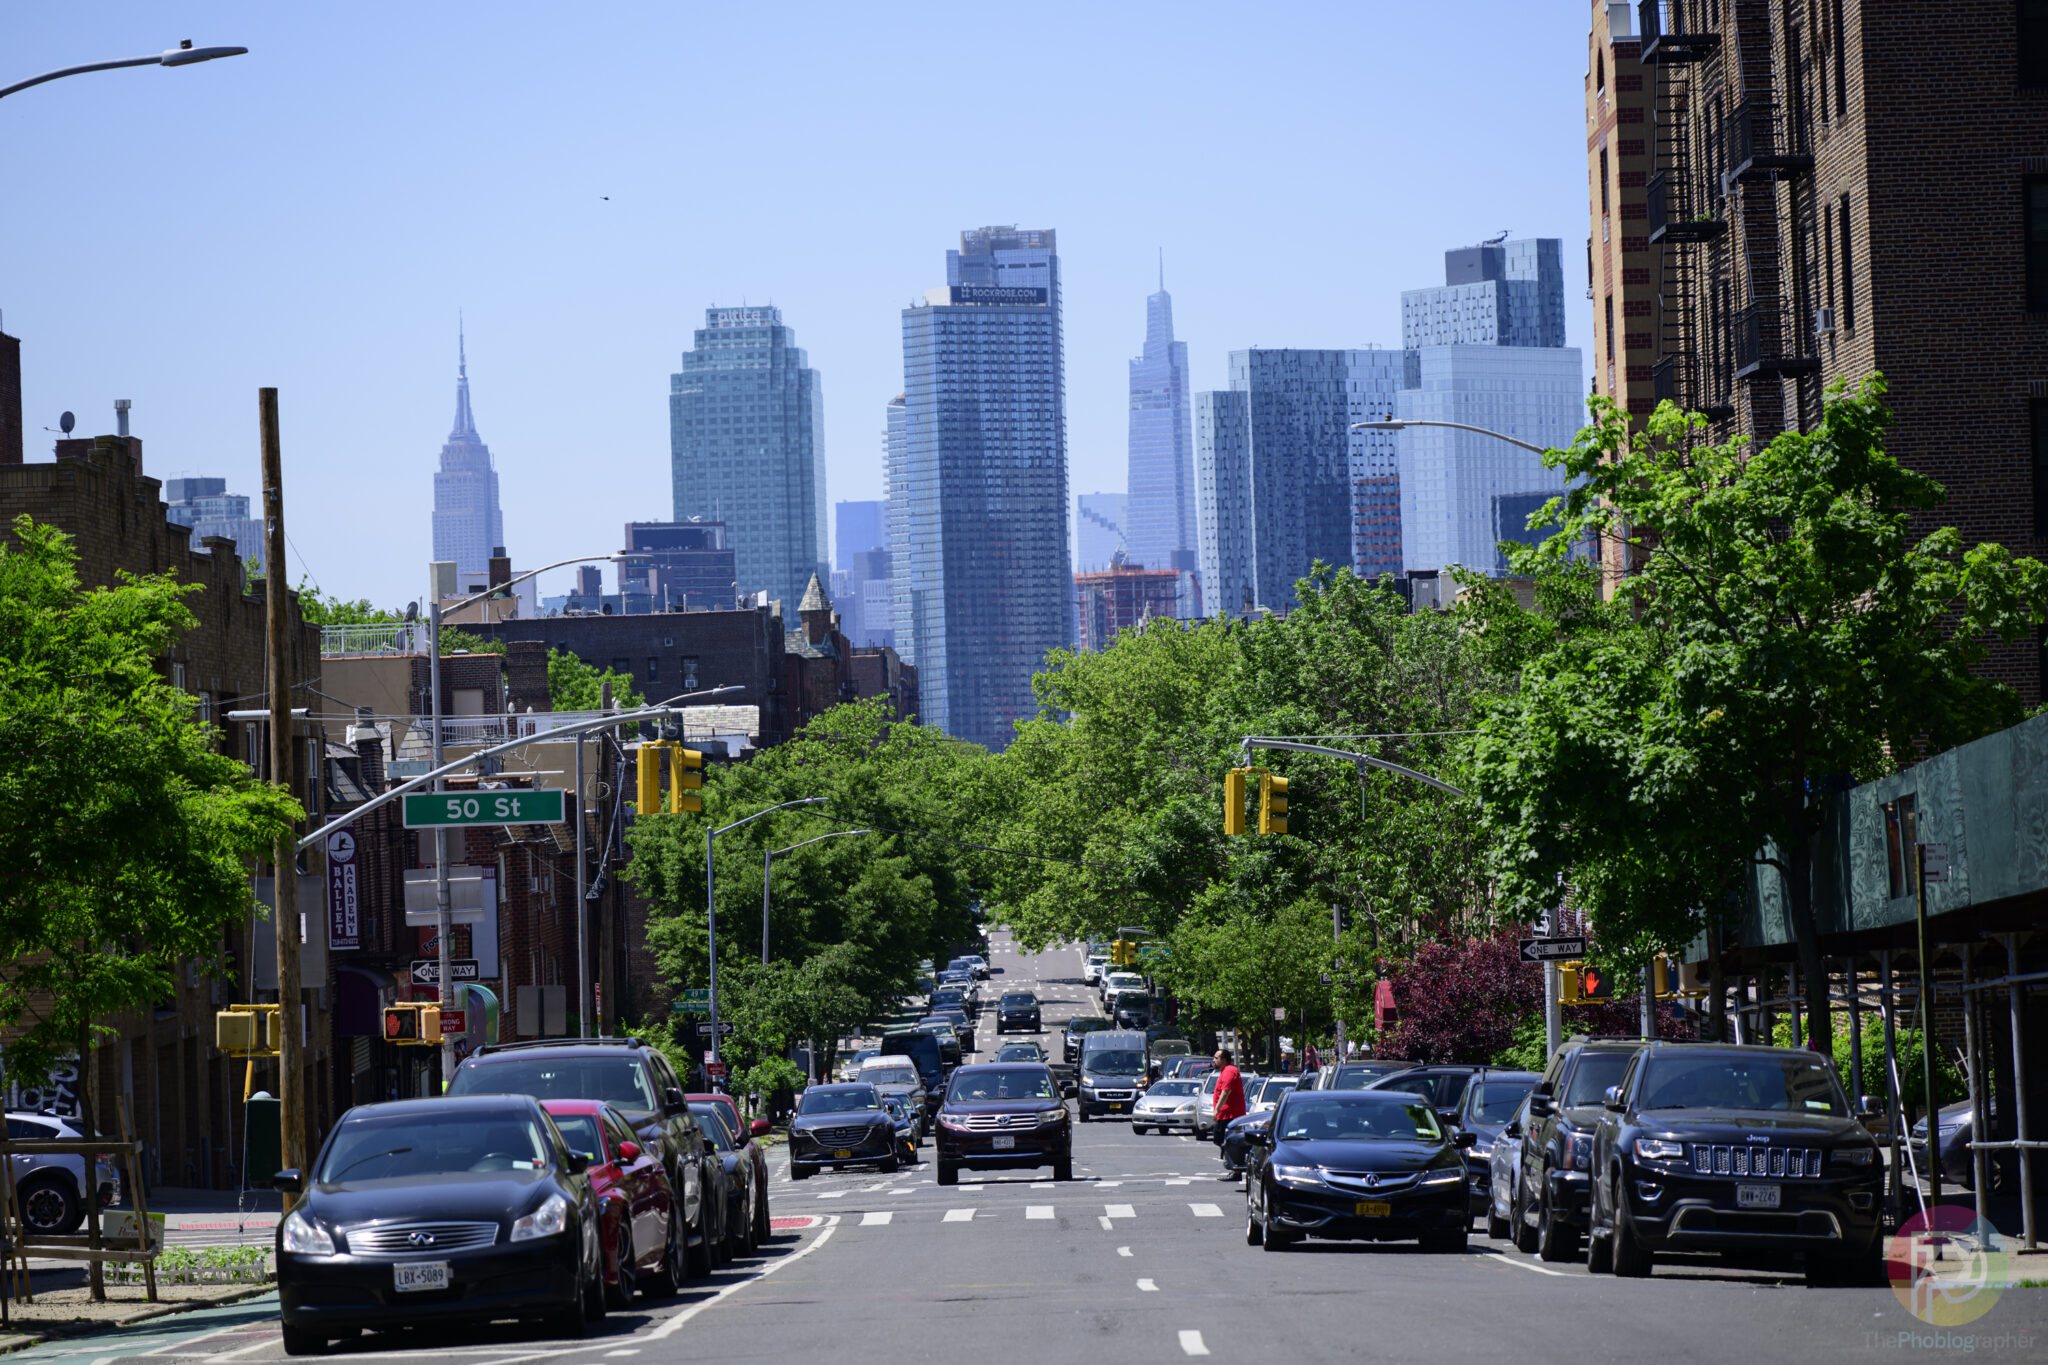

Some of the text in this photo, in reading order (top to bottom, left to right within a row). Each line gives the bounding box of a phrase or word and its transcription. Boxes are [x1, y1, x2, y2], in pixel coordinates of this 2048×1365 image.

[972, 288, 1037, 297] ROCKROSE.COM
[718, 309, 760, 322] altice
[446, 797, 521, 819] 50 St
[333, 866, 344, 934] BALLET
[346, 866, 356, 934] ACADEMY
[1530, 944, 1577, 955] ONE WAY
[421, 966, 473, 977] ONE WAY
[440, 1018, 460, 1026] WRONG
[1746, 1134, 1770, 1143] Jeep
